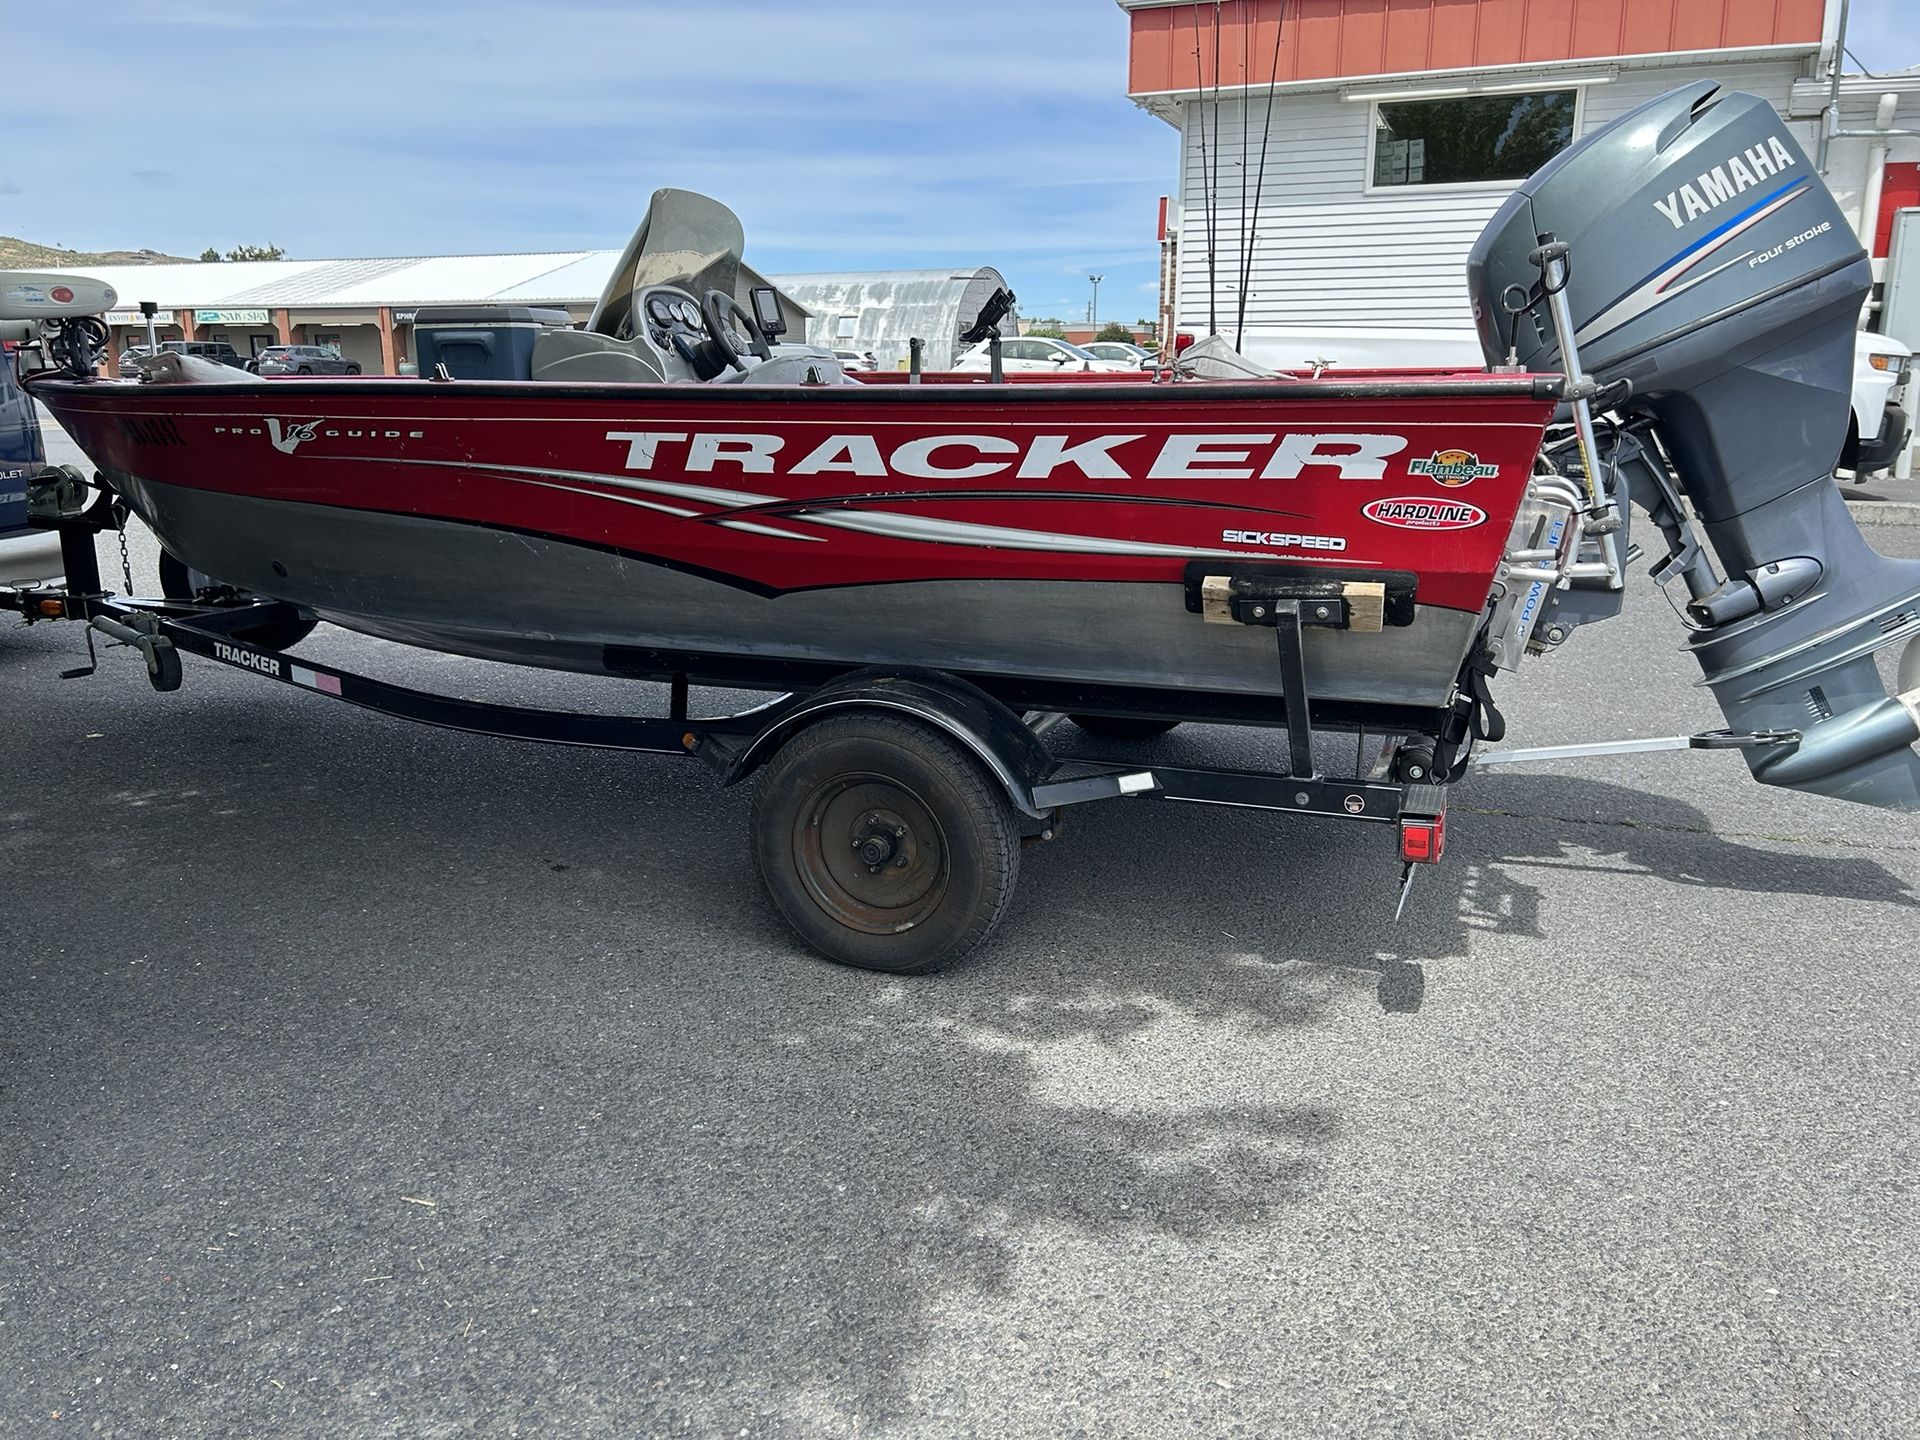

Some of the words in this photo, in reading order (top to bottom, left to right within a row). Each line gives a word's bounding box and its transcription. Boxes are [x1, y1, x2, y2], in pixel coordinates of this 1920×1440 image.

[1653, 136, 1796, 229] YAMAHA
[109, 314, 128, 322] ENVOY
[135, 314, 171, 322] MOGAGE
[247, 312, 268, 320] SPA
[214, 427, 262, 435] PRO
[326, 430, 424, 439] GUIDE
[605, 432, 1408, 480] TRACKER
[1410, 460, 1496, 477] Flambeau
[1377, 503, 1472, 522] HARDLINE
[1406, 519, 1441, 527] products
[1222, 529, 1346, 551] SICKSPEED
[214, 642, 280, 676] TRACKER
